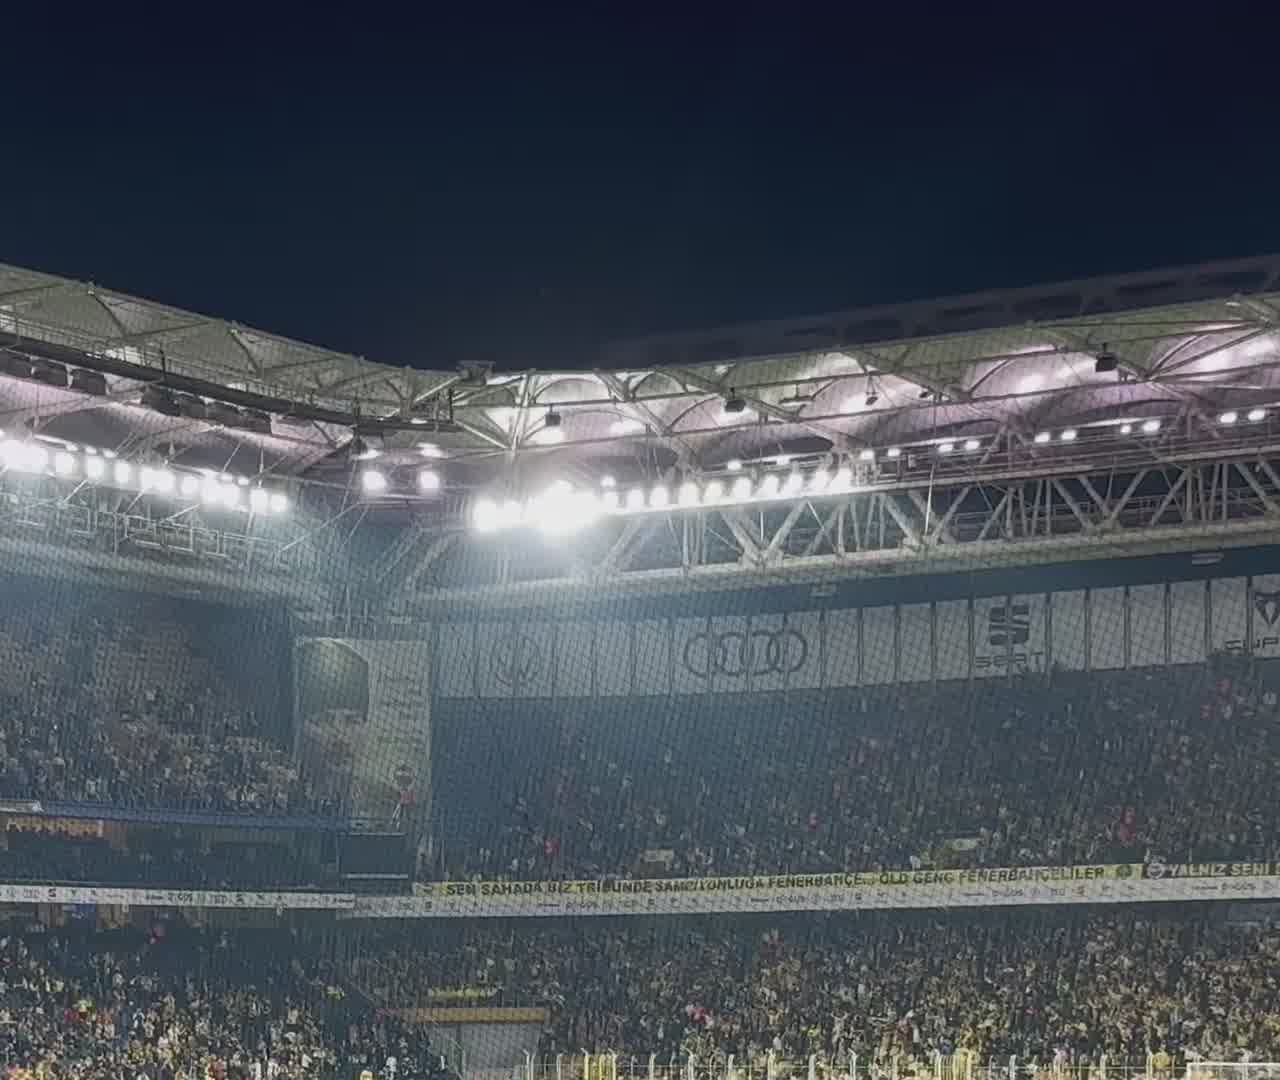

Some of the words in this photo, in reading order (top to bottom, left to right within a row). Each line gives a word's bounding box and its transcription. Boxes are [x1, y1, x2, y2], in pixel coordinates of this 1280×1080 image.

[1169, 863, 1225, 877] YALNIZ
[447, 883, 476, 896] SEN
[481, 881, 542, 896] SAHADA
